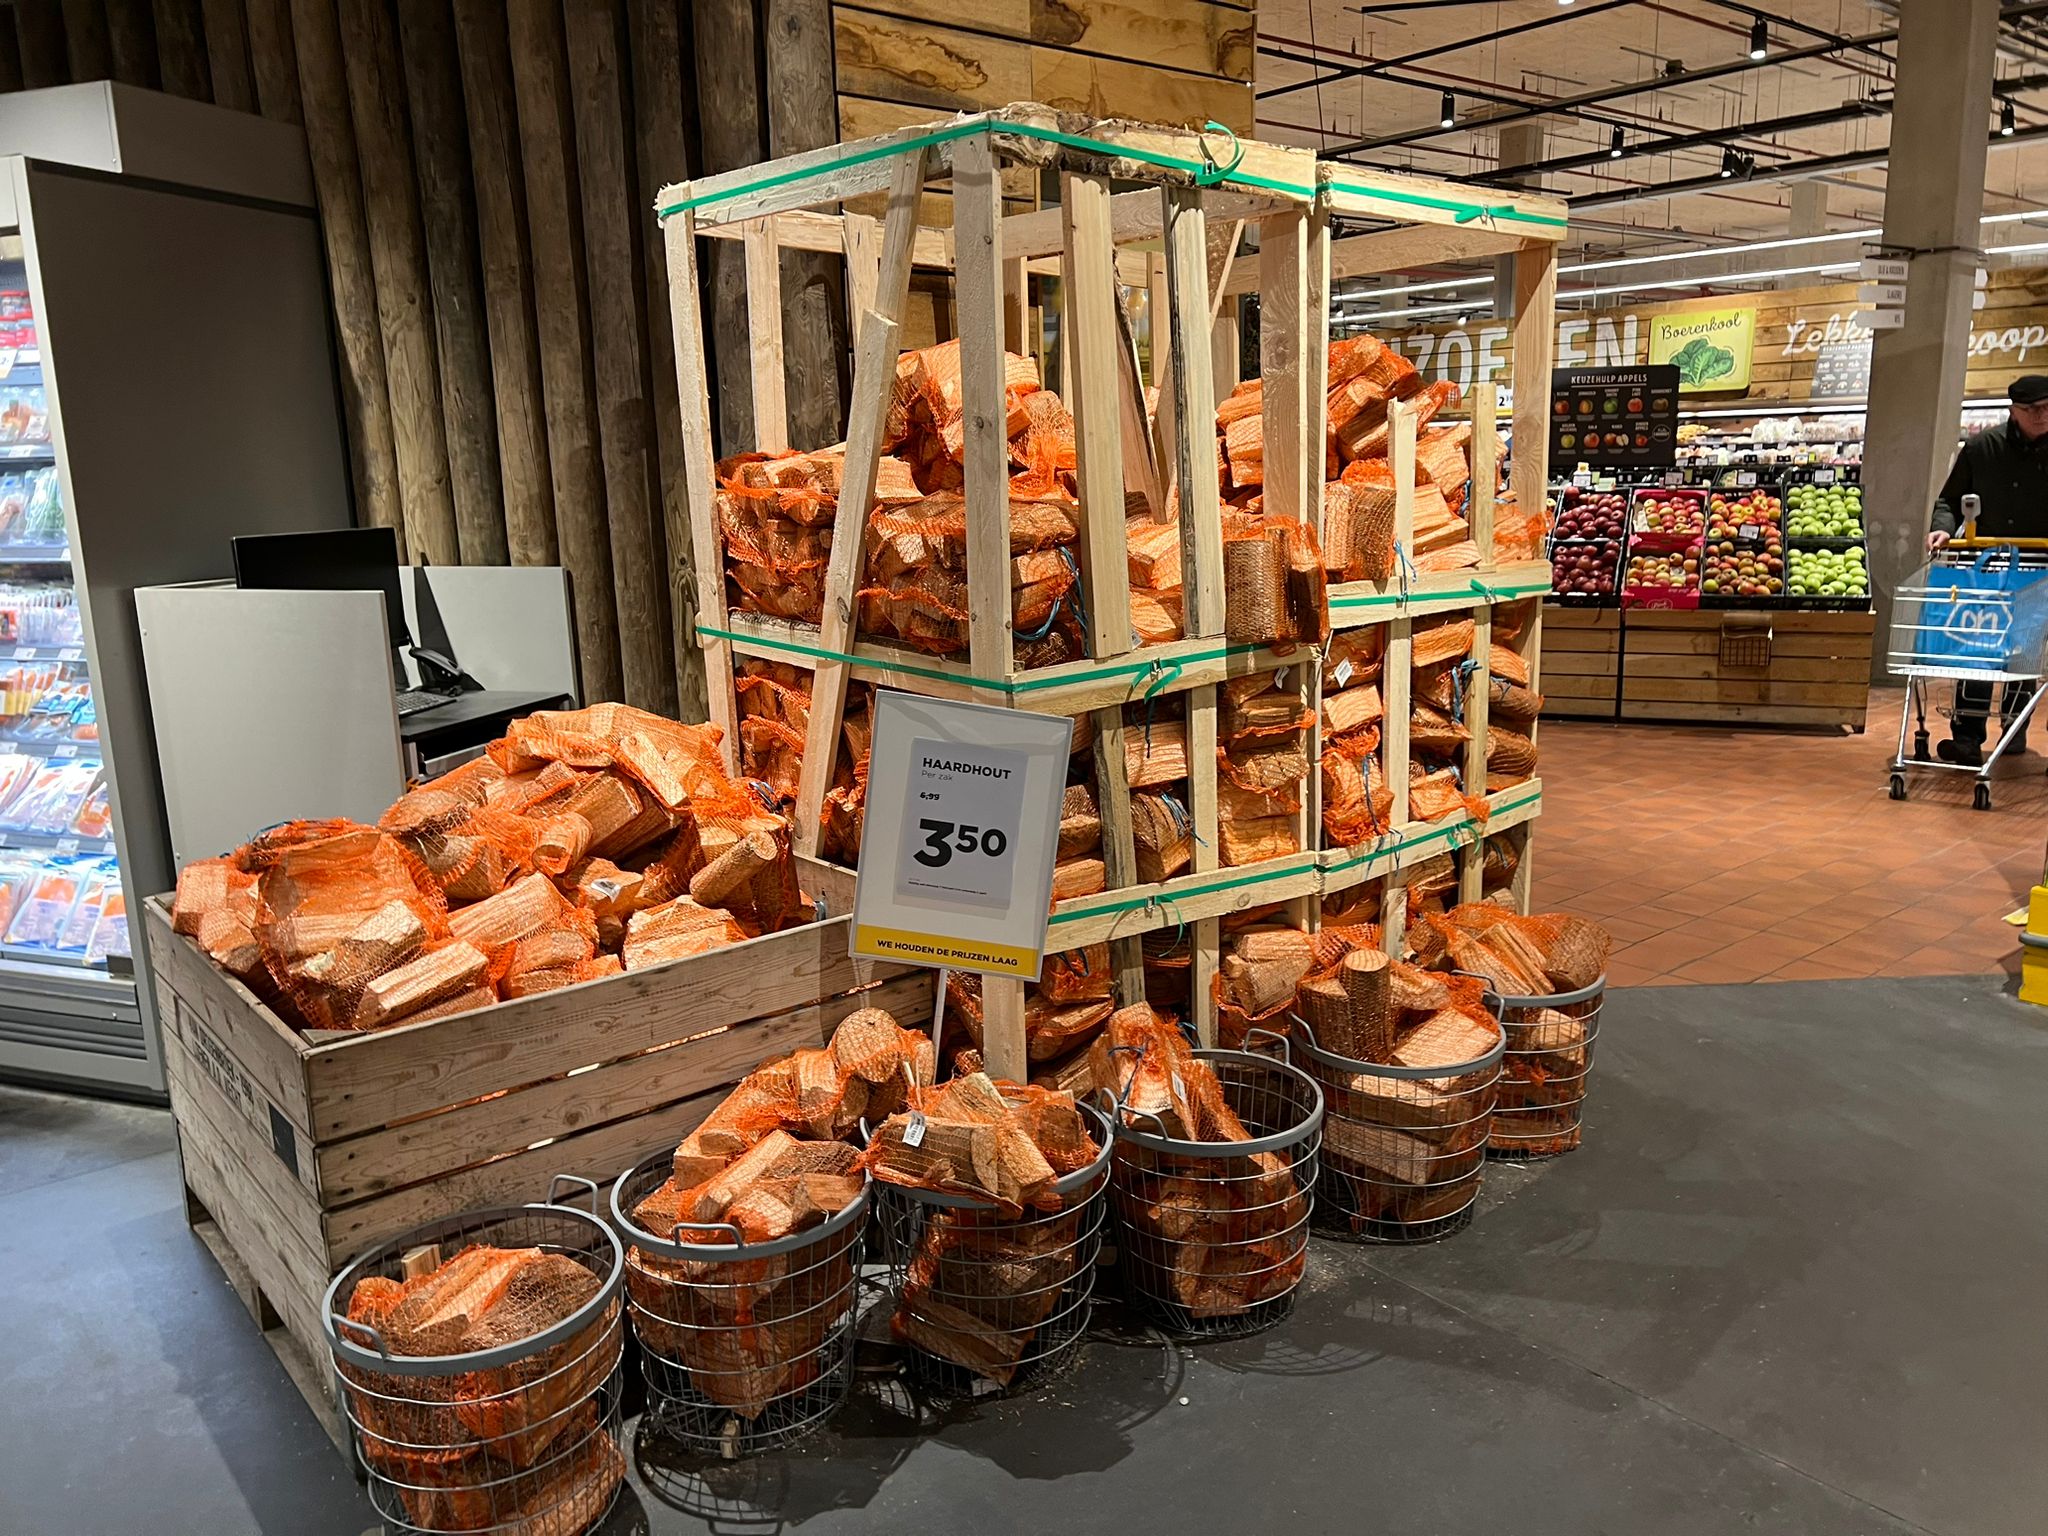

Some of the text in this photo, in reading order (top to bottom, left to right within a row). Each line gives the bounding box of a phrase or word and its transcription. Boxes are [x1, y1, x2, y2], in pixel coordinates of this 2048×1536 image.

[1661, 312, 1742, 340] Boerenkool
[1571, 374, 1648, 384] KEUZEHULP APPELS
[921, 769, 954, 781] Per zak
[922, 757, 1012, 780] HAARDHOUT
[877, 939, 1018, 967] WE HOUDEN DE PRIJZEN LAAG
